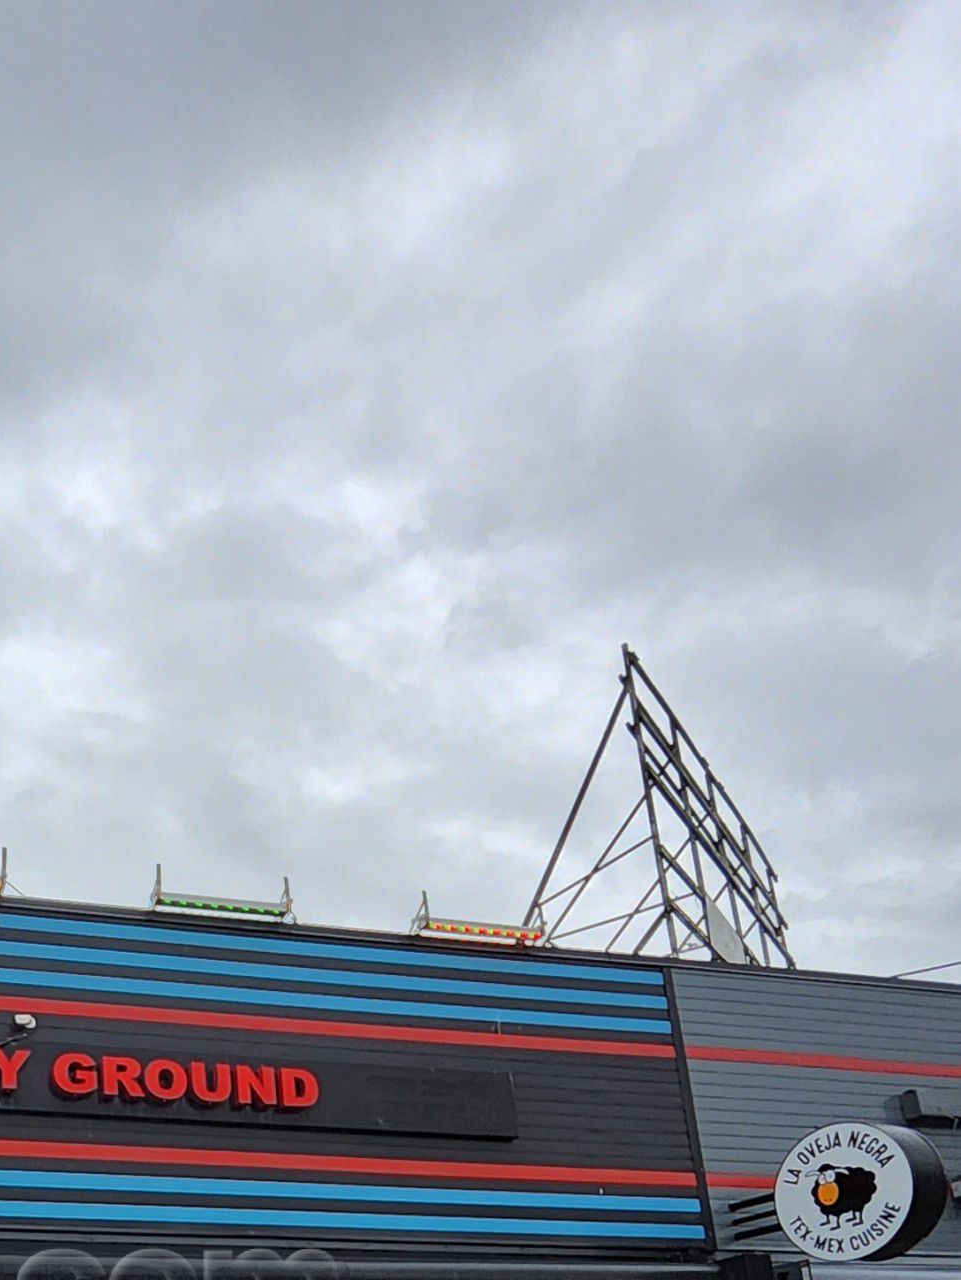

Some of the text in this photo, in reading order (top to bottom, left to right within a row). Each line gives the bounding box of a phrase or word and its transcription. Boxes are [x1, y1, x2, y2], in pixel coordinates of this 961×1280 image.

[51, 1053, 320, 1109] GROUND
[783, 1130, 896, 1185] LA OVEJA NEGRA
[789, 1201, 901, 1253] TEX-MEX CUISINE
